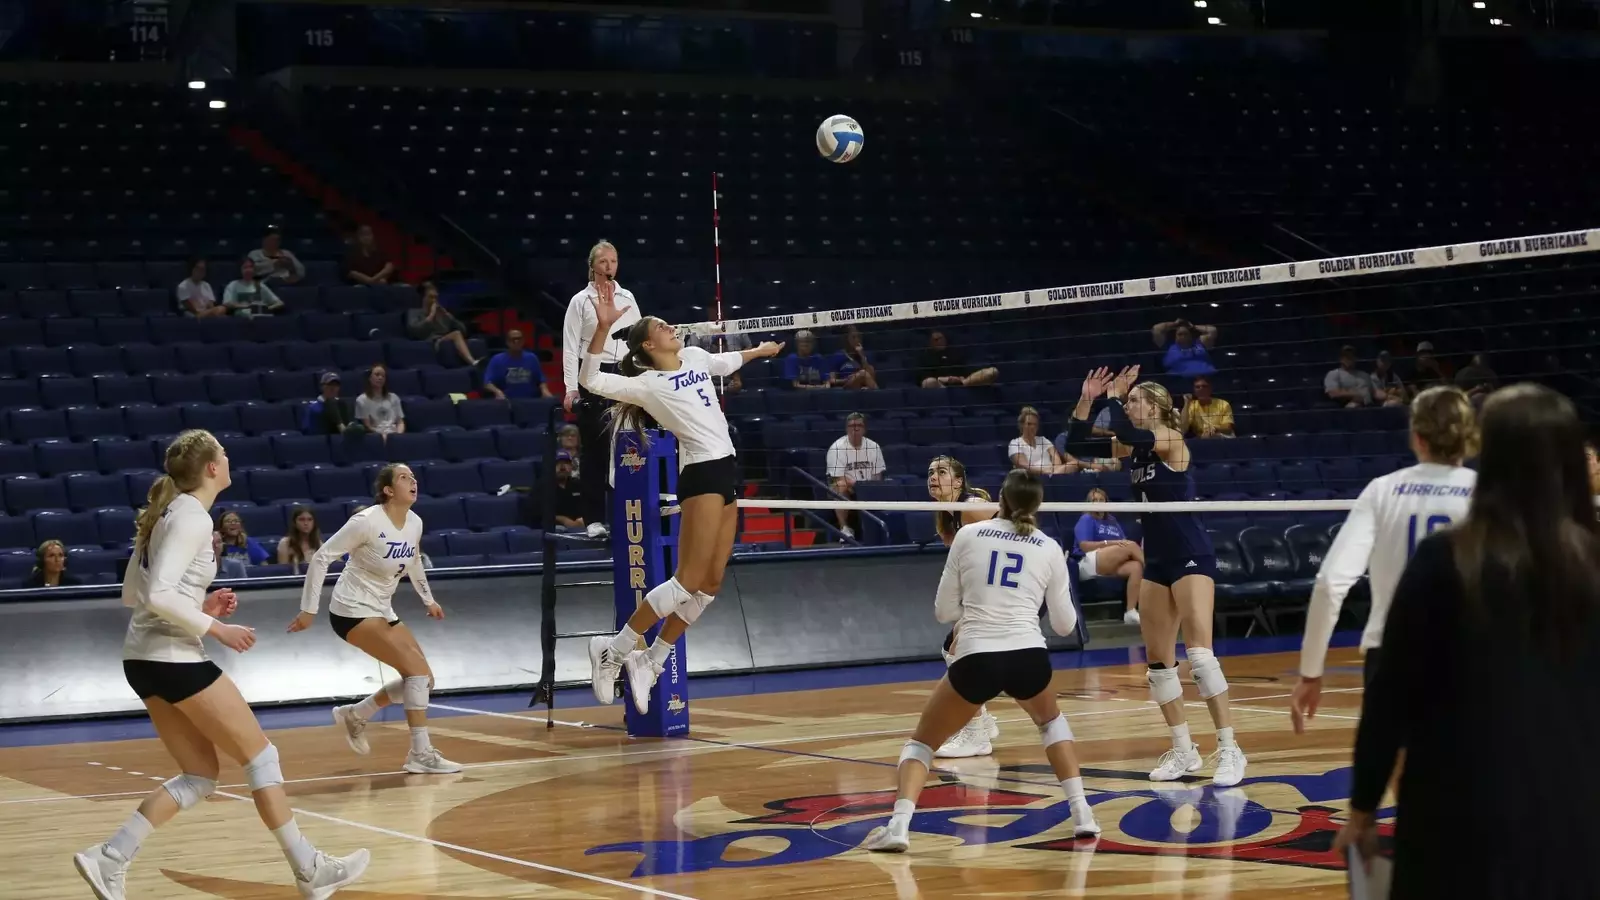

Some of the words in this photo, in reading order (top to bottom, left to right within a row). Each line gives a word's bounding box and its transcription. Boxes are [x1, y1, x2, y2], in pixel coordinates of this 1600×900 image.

[130, 25, 159, 43] 114
[305, 29, 334, 47] 115
[899, 51, 922, 66] 115
[1479, 240, 1521, 257] GOLDEN
[1523, 233, 1588, 252] HURRICANE
[1318, 259, 1355, 273] GOLDEN
[1358, 252, 1415, 269] HURRICANE
[1175, 274, 1209, 288] GOLDEN
[1211, 268, 1261, 284] HURRICANE
[1047, 288, 1077, 301] GOLDEN
[1080, 282, 1124, 297] HURRICANE
[933, 300, 960, 312] GOLDEN
[962, 295, 1002, 309] HURRICANE
[737, 319, 760, 330] GOLDEN
[761, 315, 795, 328] HURRICANE
[831, 309, 857, 321] GOLDEN
[857, 306, 893, 319] HURRICANE
[668, 370, 709, 391] Tulsa
[696, 388, 711, 407] 5
[1392, 483, 1473, 497] HURRICAN
[976, 528, 1045, 547] HURRICANE
[987, 550, 1023, 588] 12
